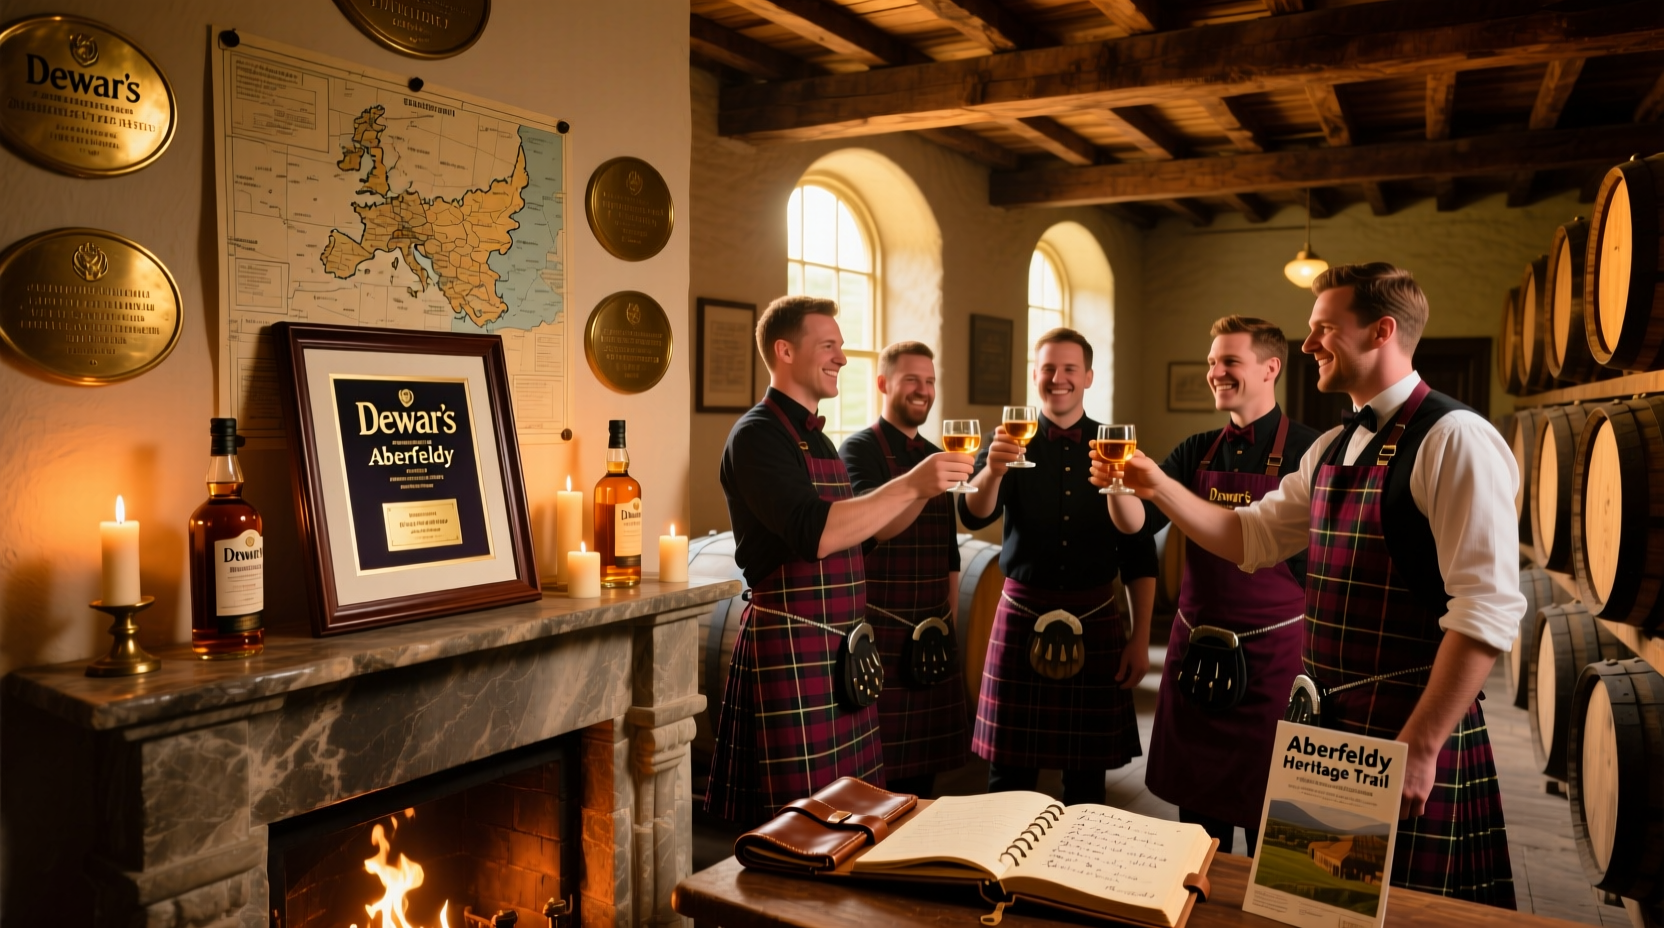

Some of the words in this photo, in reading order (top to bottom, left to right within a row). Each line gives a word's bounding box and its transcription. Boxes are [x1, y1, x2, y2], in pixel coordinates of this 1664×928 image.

[26, 53, 141, 103] Dewar's
[355, 401, 457, 436] Dewar's
[368, 445, 454, 468] Aberfeldy
[1283, 754, 1350, 782] Heritage
[1354, 768, 1390, 789] Trail
[1286, 735, 1393, 775] Aberfeldy
